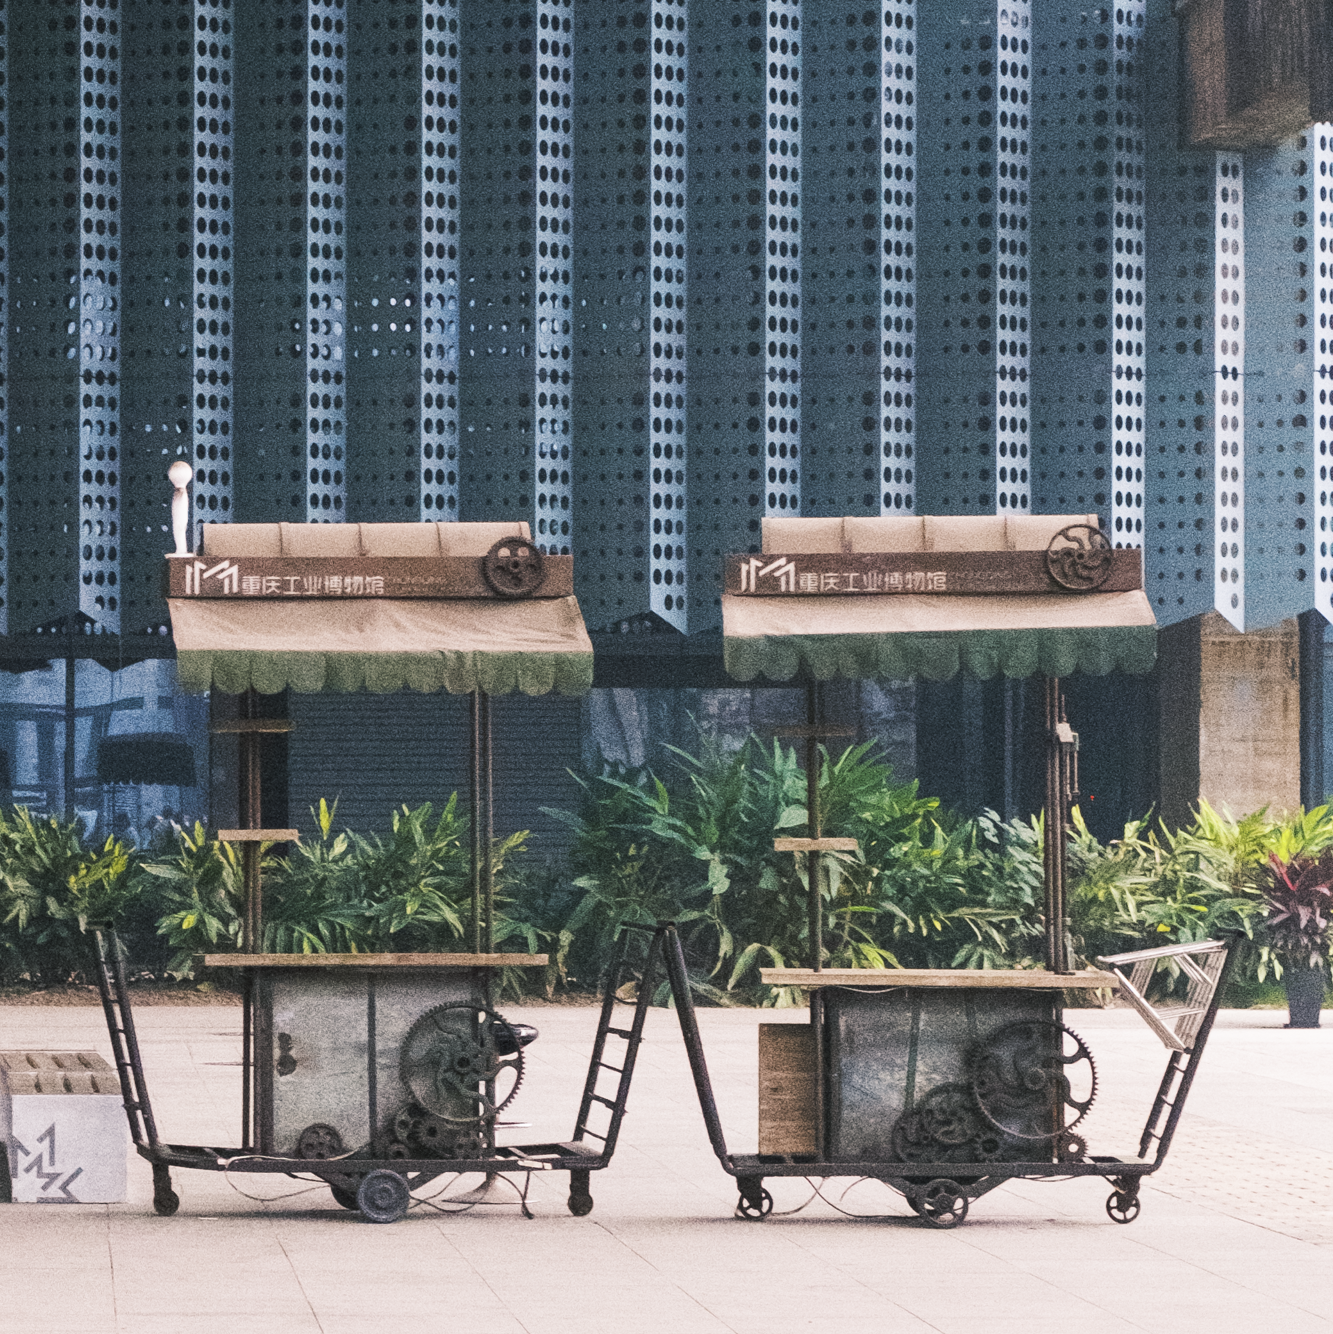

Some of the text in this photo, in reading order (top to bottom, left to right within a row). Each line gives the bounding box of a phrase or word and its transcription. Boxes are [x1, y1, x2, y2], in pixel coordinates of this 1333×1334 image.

[242, 576, 384, 595] 重庆工业博物馆
[799, 572, 947, 592] 重庆工业博物馆
